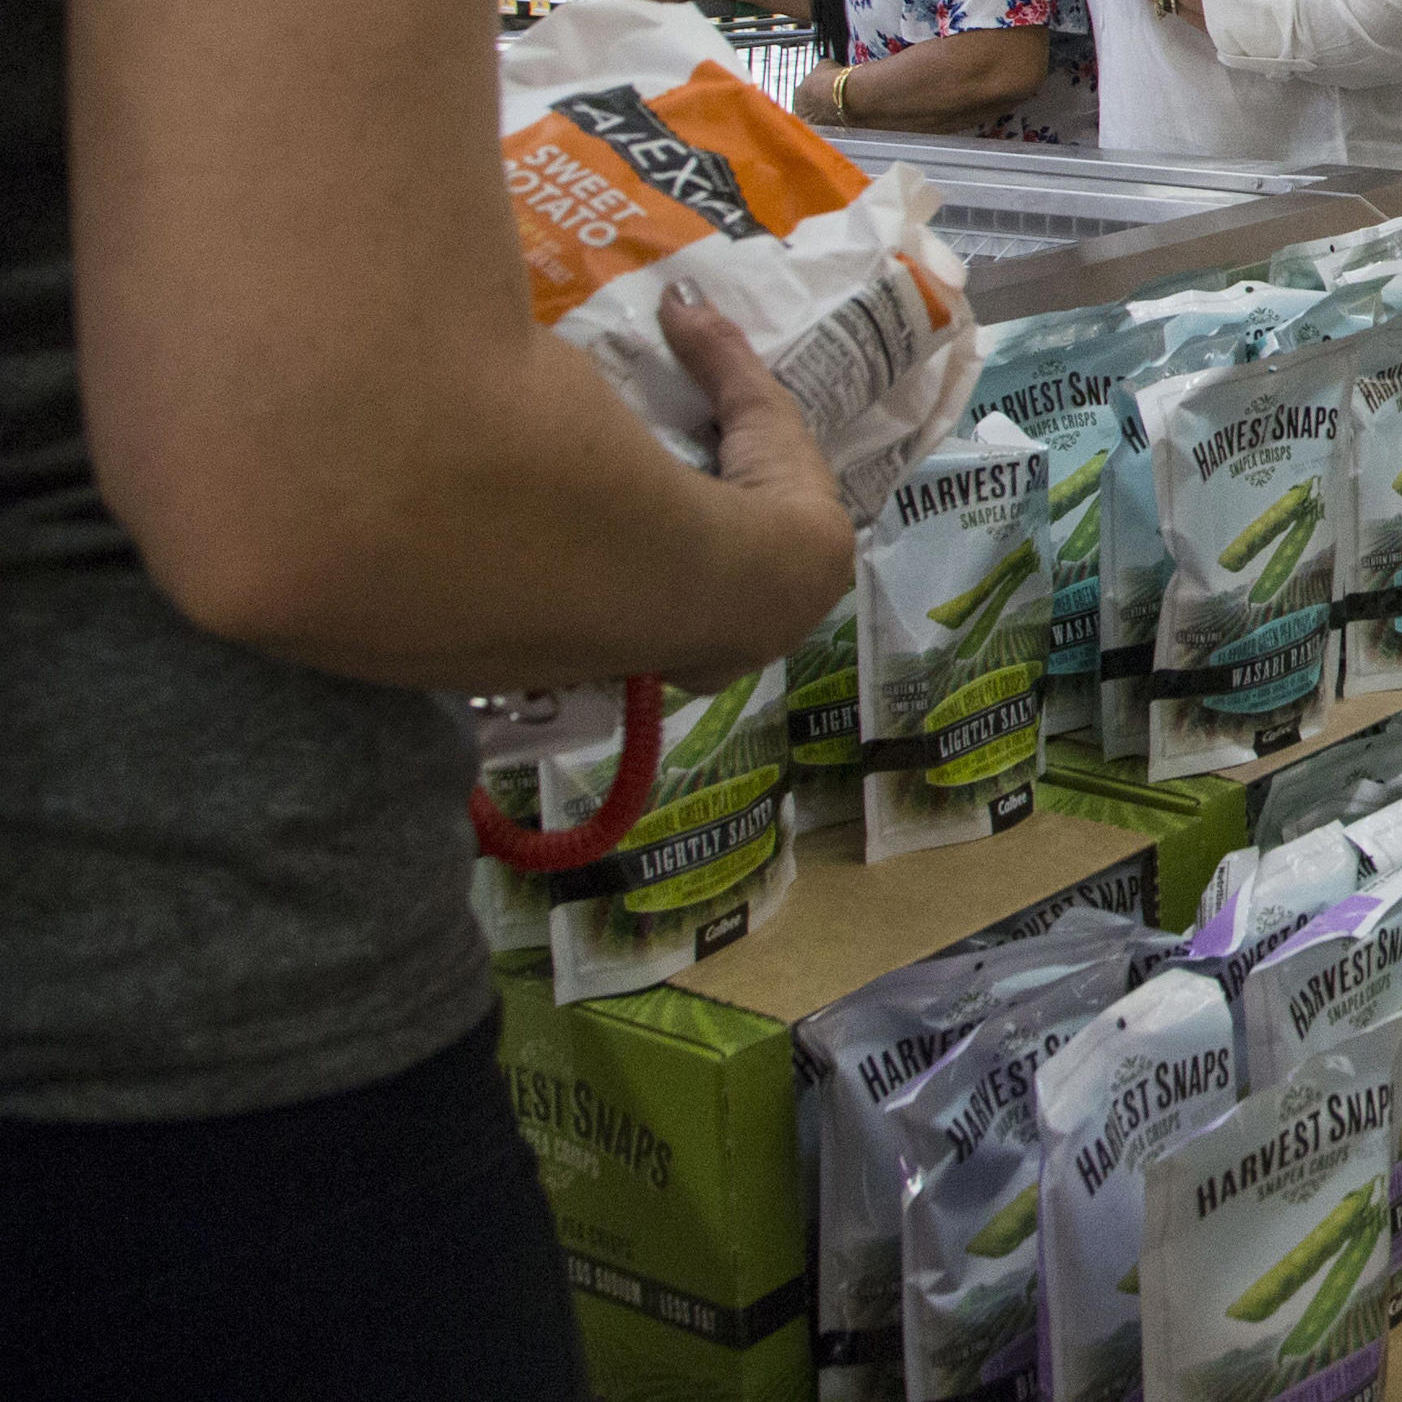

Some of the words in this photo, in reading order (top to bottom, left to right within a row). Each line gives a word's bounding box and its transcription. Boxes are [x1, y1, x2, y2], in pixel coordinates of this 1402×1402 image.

[523, 145, 648, 221] SWEET
[1062, 410, 1097, 429] CRISPS
[1192, 415, 1272, 483] HARVEST
[1271, 406, 1338, 441] SNAPS
[1259, 445, 1292, 469] CRISPS
[896, 459, 1021, 527] HARVEST
[960, 507, 1008, 531] SNAPEA
[1232, 656, 1285, 688] WASABI
[938, 714, 995, 760] LIGHTLY
[997, 791, 1029, 818] Calbee
[641, 830, 723, 881] LIGHTLY
[704, 915, 742, 943] Calbee
[1289, 939, 1376, 1041] HARVEST
[572, 1080, 673, 1189] SNAPS
[947, 1049, 1042, 1166] HARVEST
[1075, 1088, 1152, 1198] HARVEST
[1154, 1046, 1231, 1109] SNAPS
[1196, 1109, 1321, 1221] HARVEST
[1256, 1169, 1306, 1202] SNAPEA
[1309, 1147, 1350, 1179] CRISPS
